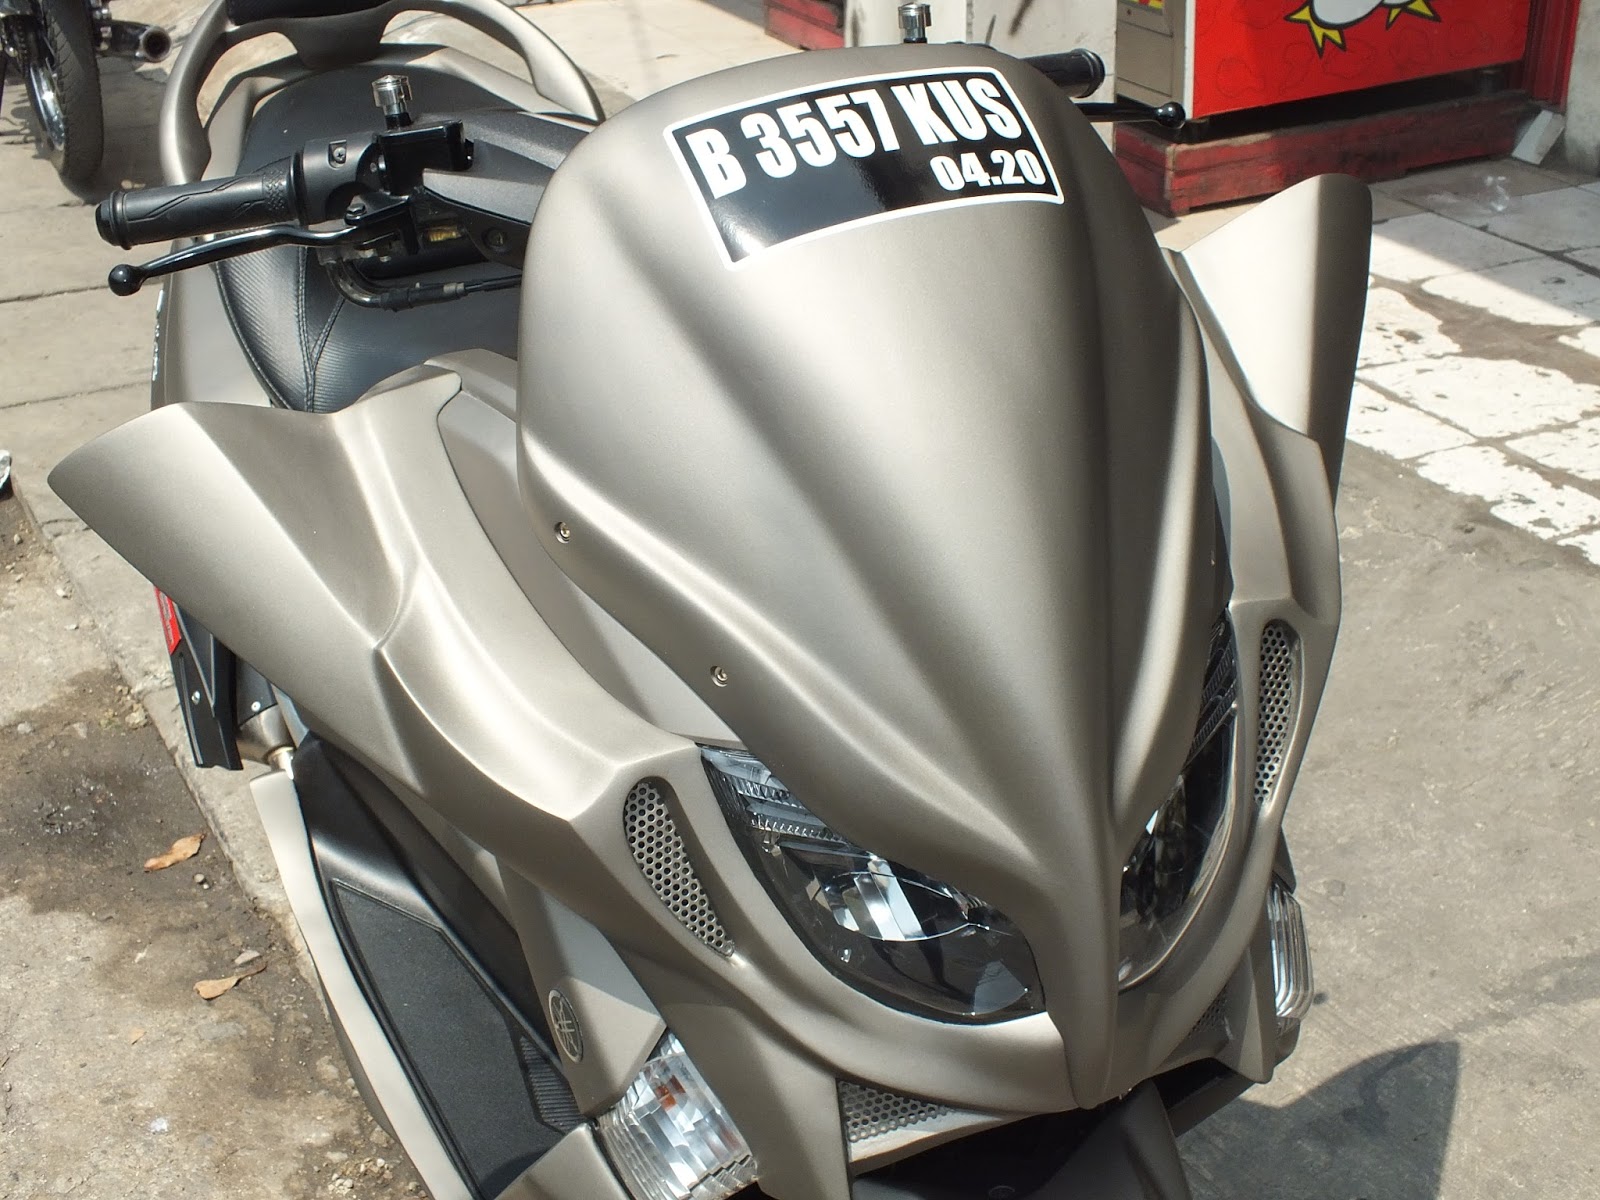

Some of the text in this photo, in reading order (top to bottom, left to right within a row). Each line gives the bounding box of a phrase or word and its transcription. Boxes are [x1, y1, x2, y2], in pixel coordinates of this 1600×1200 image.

[686, 78, 1021, 199] B 3557 KUS
[930, 149, 1046, 190] 04.20
